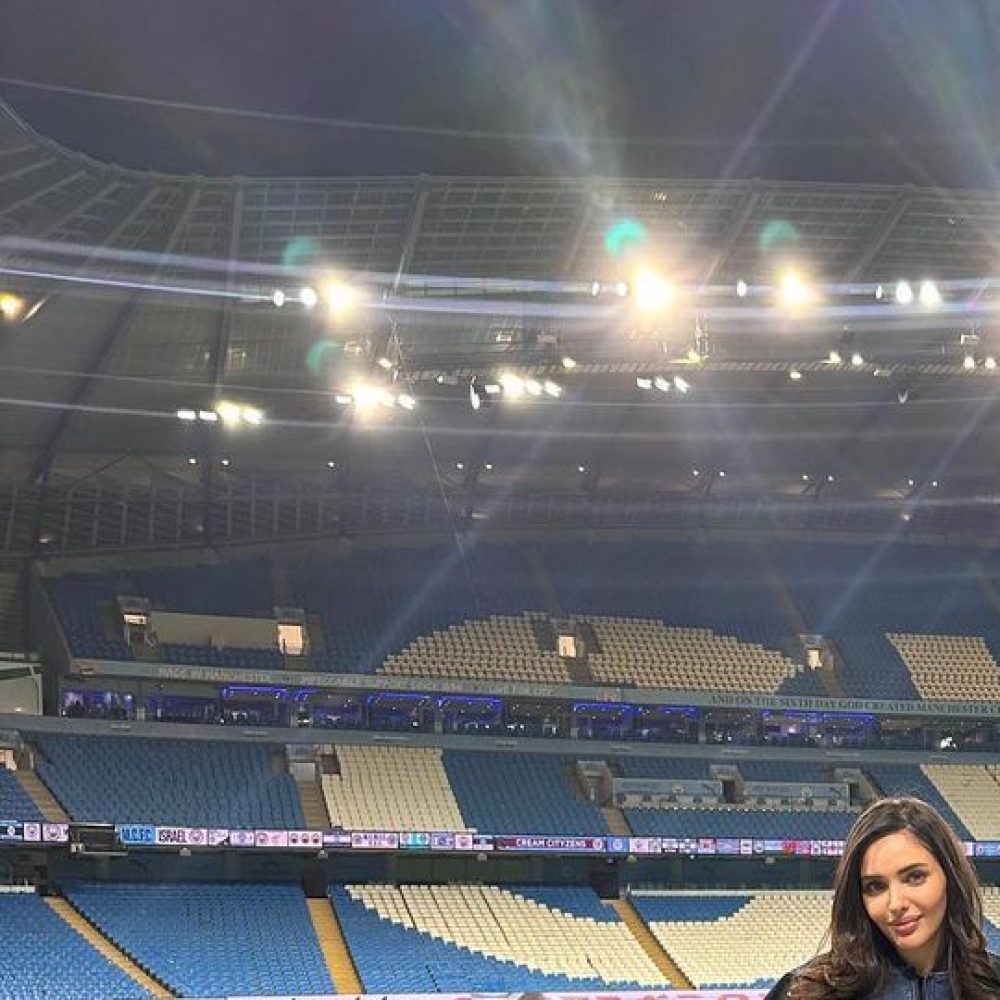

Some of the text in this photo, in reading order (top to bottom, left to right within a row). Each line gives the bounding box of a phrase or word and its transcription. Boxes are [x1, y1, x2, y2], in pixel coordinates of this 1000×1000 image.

[863, 701, 918, 711] CREATED
[919, 702, 987, 713] MANCHESTER
[516, 838, 544, 848] CREAM
